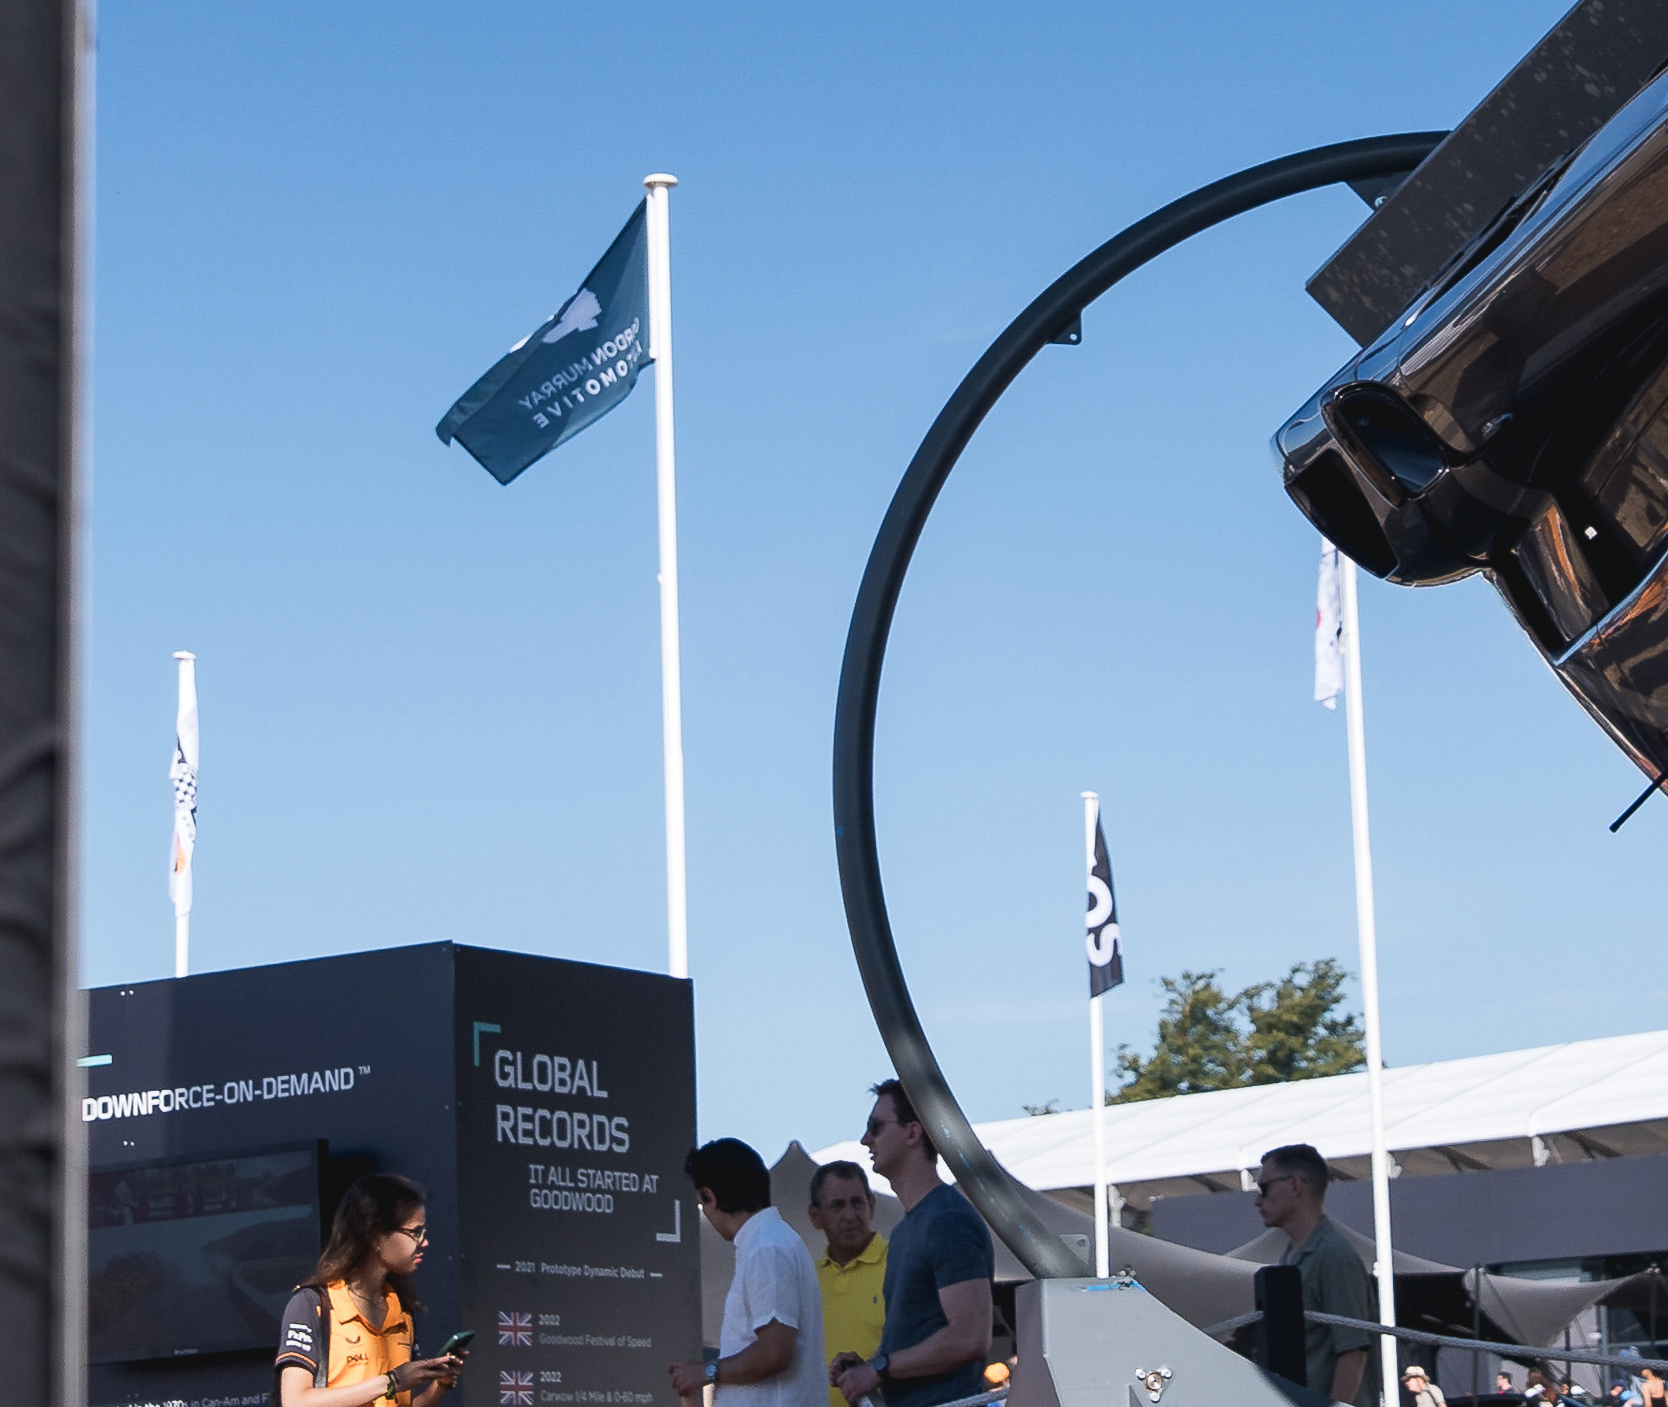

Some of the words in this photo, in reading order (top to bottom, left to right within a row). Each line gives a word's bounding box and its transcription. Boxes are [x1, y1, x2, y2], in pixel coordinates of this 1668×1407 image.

[494, 1049, 608, 1097] GLOBAL
[496, 1104, 630, 1153] RECORDS
[528, 1164, 544, 1184] IT
[548, 1166, 574, 1187] ALL
[577, 1168, 639, 1192] STARTED
[642, 1174, 659, 1193] AT
[529, 1188, 614, 1213] GOODWOOD
[515, 1260, 536, 1273] 2021
[541, 1262, 581, 1277] Prototype
[583, 1264, 618, 1279] Dynamic
[620, 1266, 644, 1279] Debut
[538, 1313, 560, 1326] 2022
[539, 1333, 584, 1346] Goodwood
[585, 1334, 615, 1347] Festival
[617, 1335, 626, 1347] of
[627, 1336, 652, 1349] Speed
[540, 1370, 561, 1382] 2022
[242, 1394, 259, 1405] and
